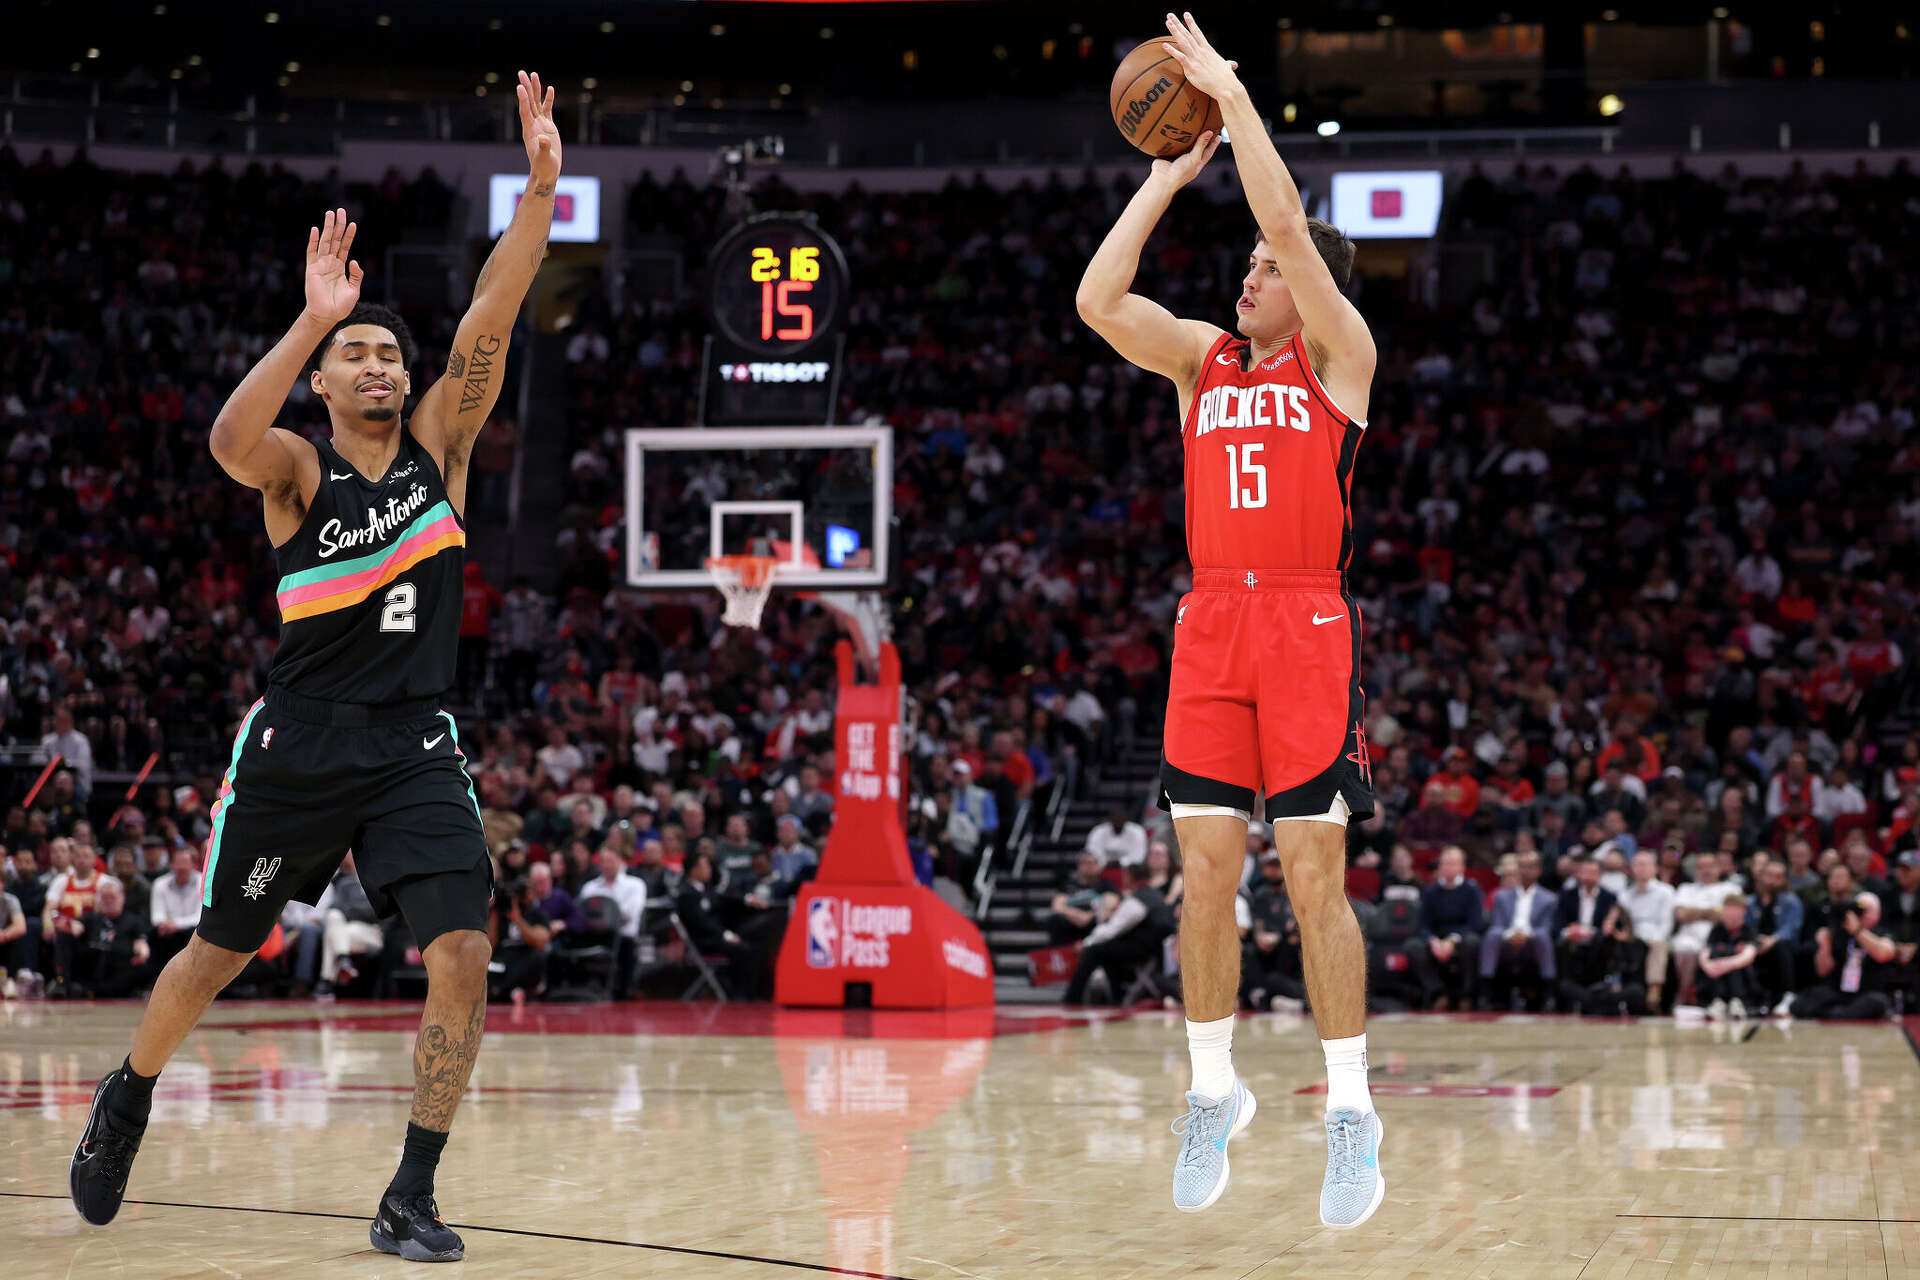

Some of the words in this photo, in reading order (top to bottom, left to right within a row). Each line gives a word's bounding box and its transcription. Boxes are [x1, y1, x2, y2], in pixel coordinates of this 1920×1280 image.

[1120, 77, 1173, 138] Wilson
[751, 246, 820, 283] 2:16
[761, 280, 813, 341] 15
[458, 333, 500, 415] WAWG
[1195, 382, 1311, 438] ROCKETS
[1224, 442, 1268, 509] 15
[379, 582, 417, 633] 2
[841, 899, 912, 939] League
[841, 934, 890, 967] Pass
